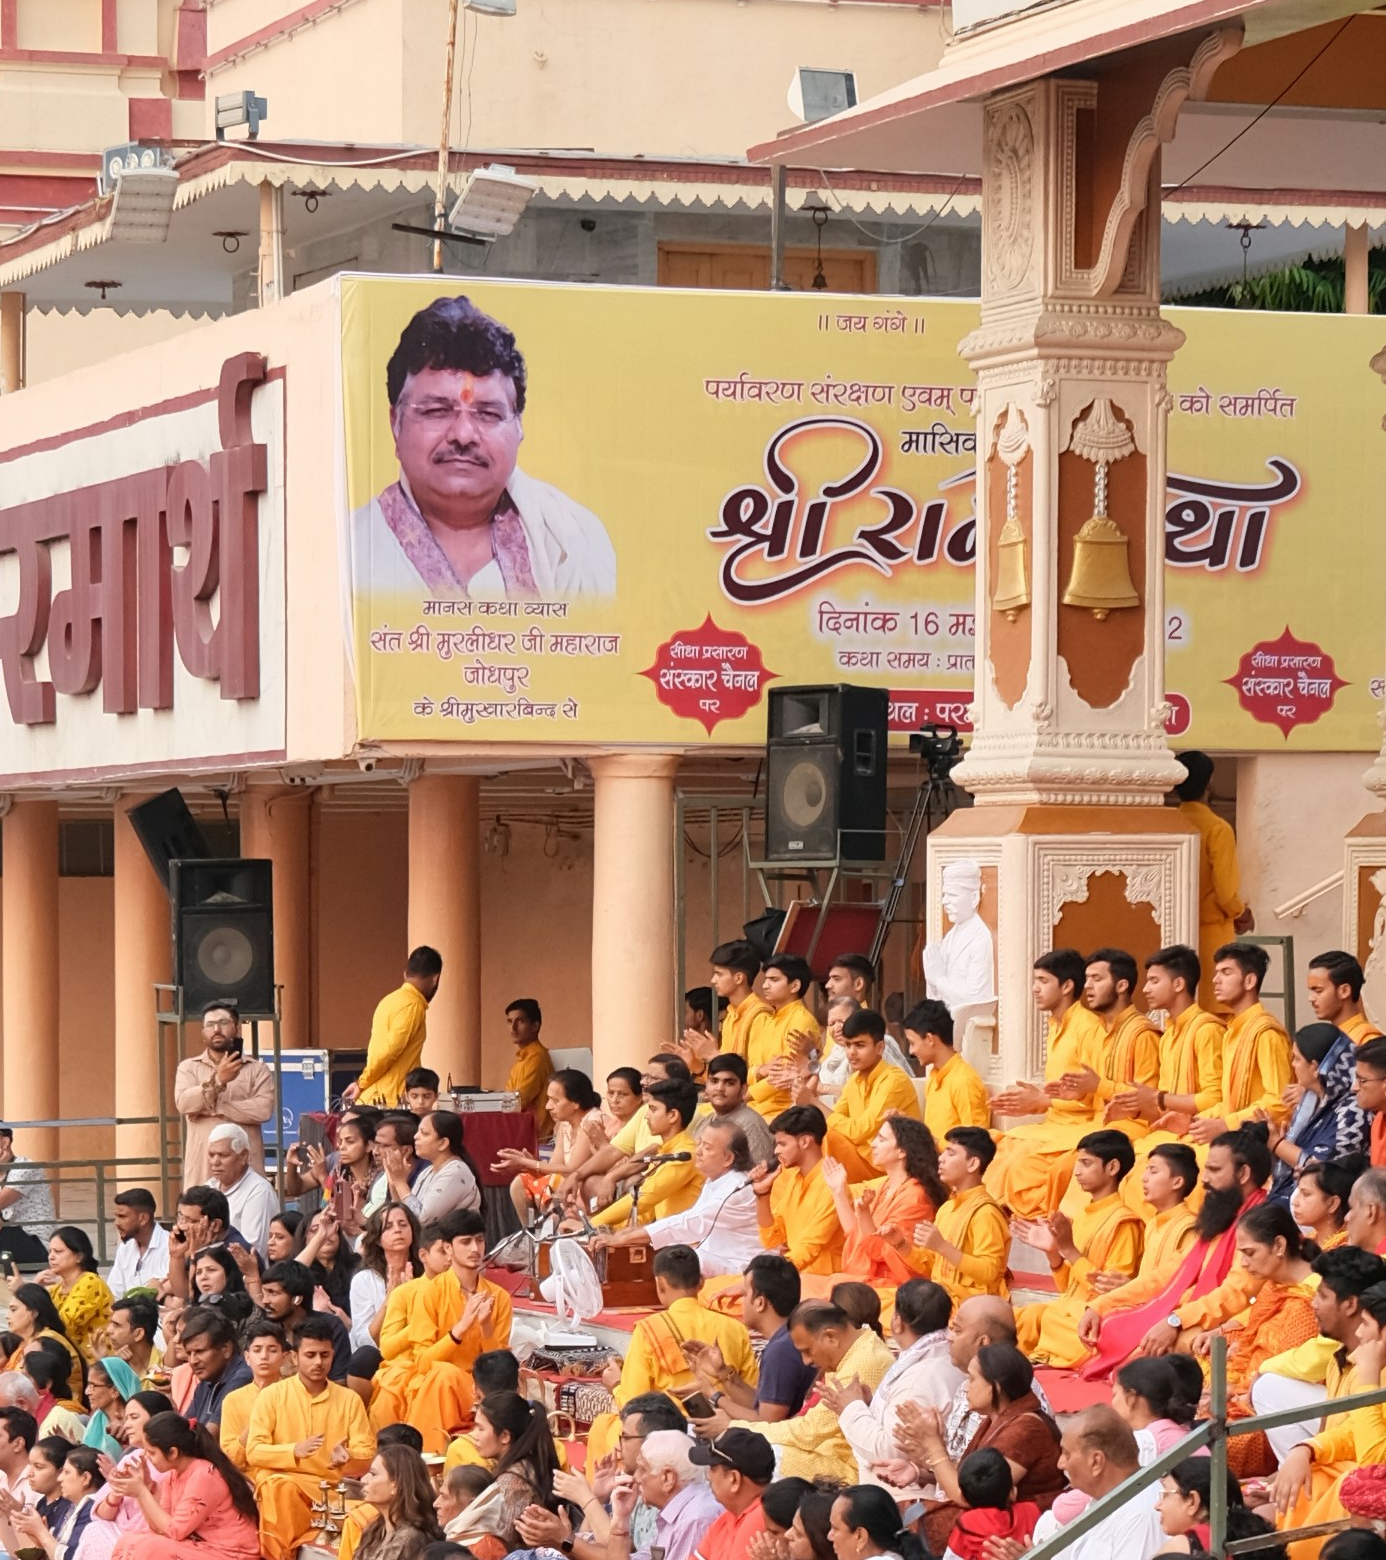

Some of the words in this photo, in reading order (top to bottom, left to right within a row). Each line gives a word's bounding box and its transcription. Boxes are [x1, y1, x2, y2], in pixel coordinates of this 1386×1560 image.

[836, 314, 867, 332] जय
[873, 310, 908, 334] गंगे
[705, 372, 804, 403] पर्यावरण
[811, 375, 895, 405] संरक्षण
[901, 386, 957, 415] एवम्
[1179, 386, 1213, 415] को
[1219, 388, 1297, 417] समर्पित
[423, 600, 471, 616] मानस
[478, 601, 517, 616] कथा
[523, 602, 569, 618] व्यास
[818, 601, 900, 635] दिनांक
[910, 612, 939, 636] 16
[370, 624, 403, 652] संत
[408, 625, 431, 653] श्री
[437, 625, 516, 659] मुरलीधर
[521, 626, 545, 654] जी
[549, 634, 620, 656] महाराज
[670, 641, 700, 659] सीधा
[702, 646, 748, 660] प्रसारण
[838, 651, 882, 668] कथा
[887, 652, 932, 669] समय
[1251, 651, 1279, 668] सीधा
[1280, 656, 1322, 670] प्रसारण
[464, 659, 529, 693] जोधपुर
[660, 662, 717, 692] संस्कार
[721, 662, 760, 691] चैनल
[1242, 670, 1294, 698] संस्कार
[1297, 671, 1332, 698] चैनल
[413, 696, 435, 718] के
[562, 697, 579, 719] से
[699, 699, 720, 713] पर
[1277, 705, 1296, 718] पर
